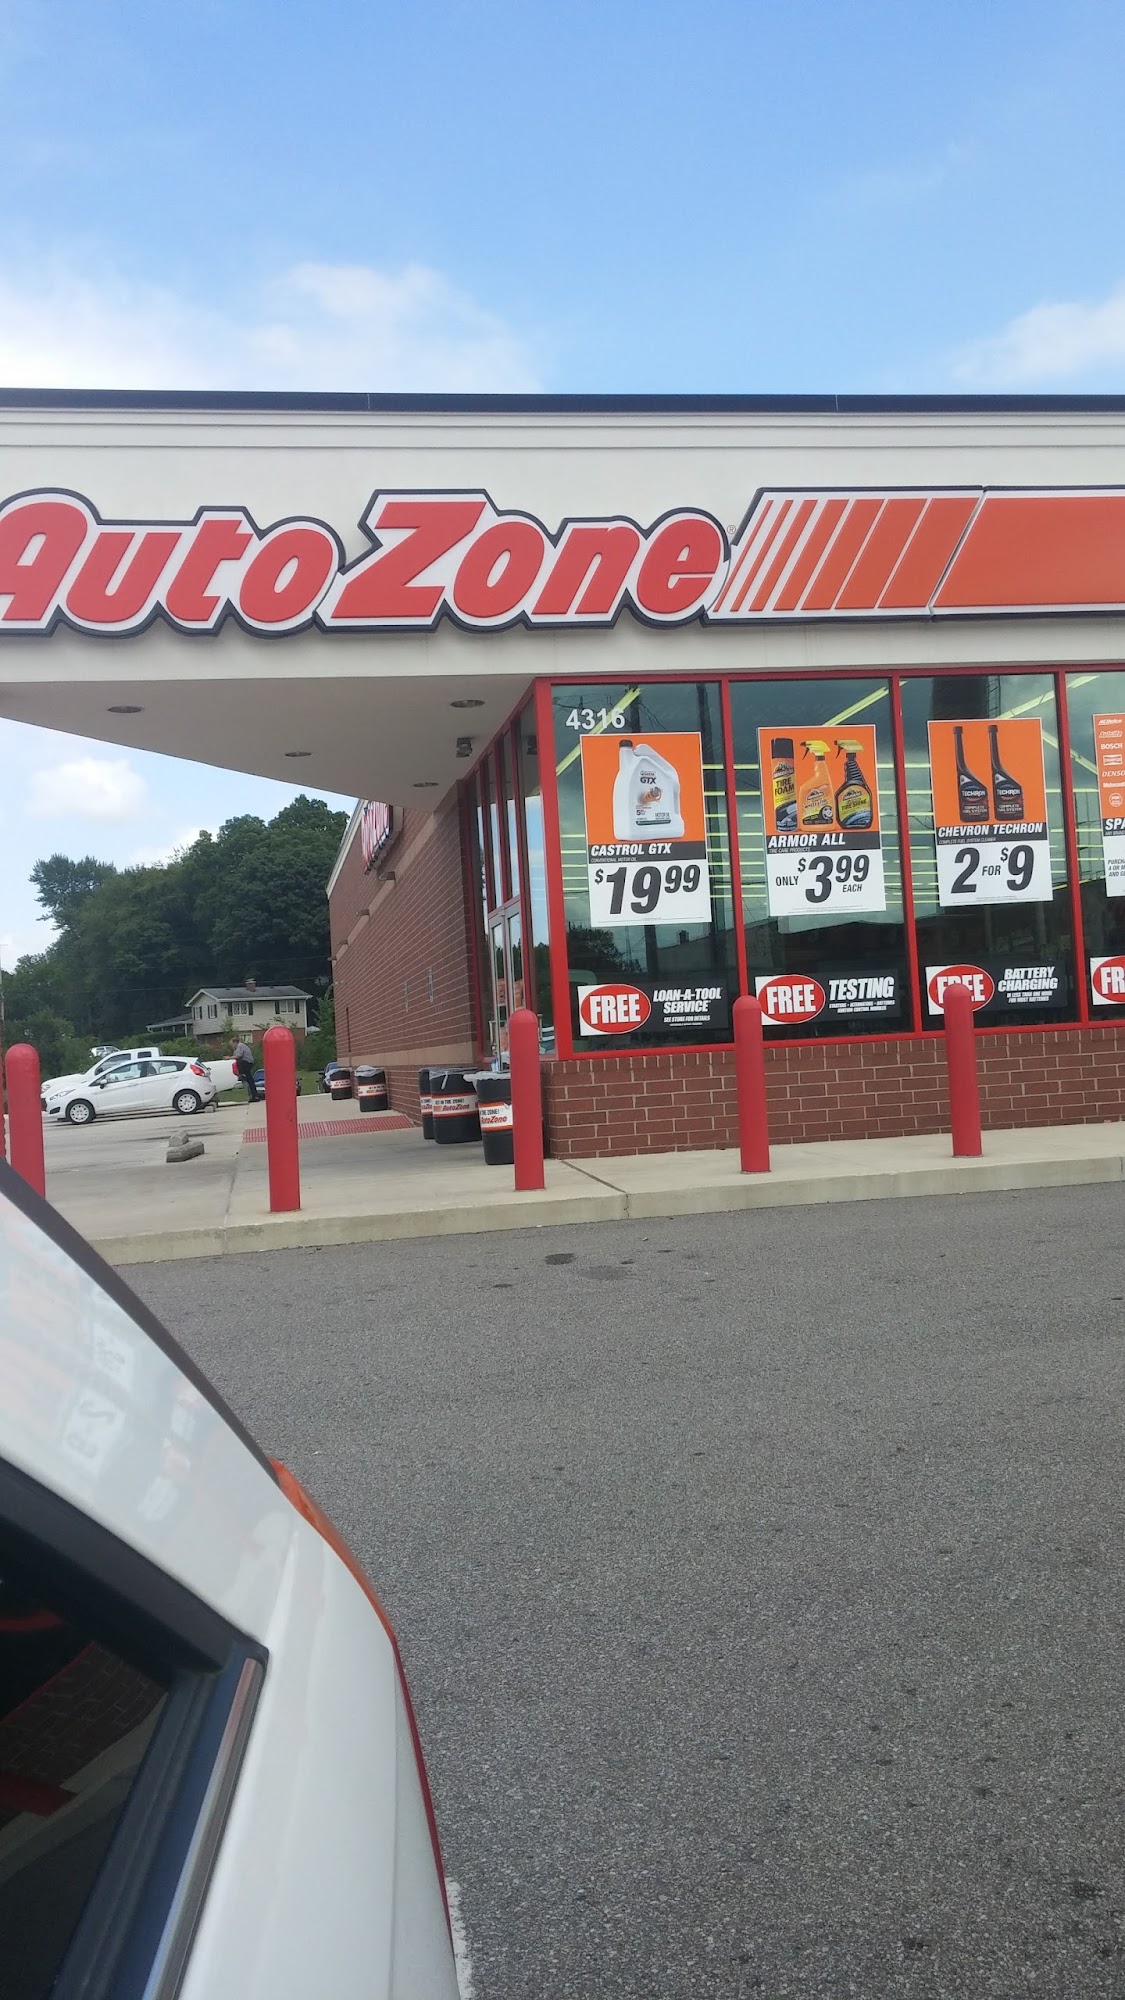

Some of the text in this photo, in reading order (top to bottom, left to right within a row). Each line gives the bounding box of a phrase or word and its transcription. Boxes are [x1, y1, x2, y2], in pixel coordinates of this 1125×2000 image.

[0, 501, 721, 623] AutoZone
[566, 708, 625, 730] 4316
[776, 777, 791, 787] TIRE
[775, 784, 794, 796] FOAM
[938, 823, 1043, 838] CHEVRON TECHRON
[768, 833, 846, 848] ARMOR ALL
[591, 843, 672, 856] CASTROL GTX
[951, 847, 980, 894] 2
[982, 865, 1001, 876] FOR
[776, 876, 799, 886] ONLY
[842, 884, 862, 893] EACH
[1004, 966, 1055, 980] BATTERY
[1100, 966, 1125, 995] FR
[828, 976, 895, 1001] TESTING
[998, 978, 1058, 992] CHARGING
[652, 987, 722, 1002] LOAN-A-TOOL
[766, 983, 816, 1015] FREE
[589, 993, 641, 1025] FREE
[663, 1000, 709, 1014] SERVICE
